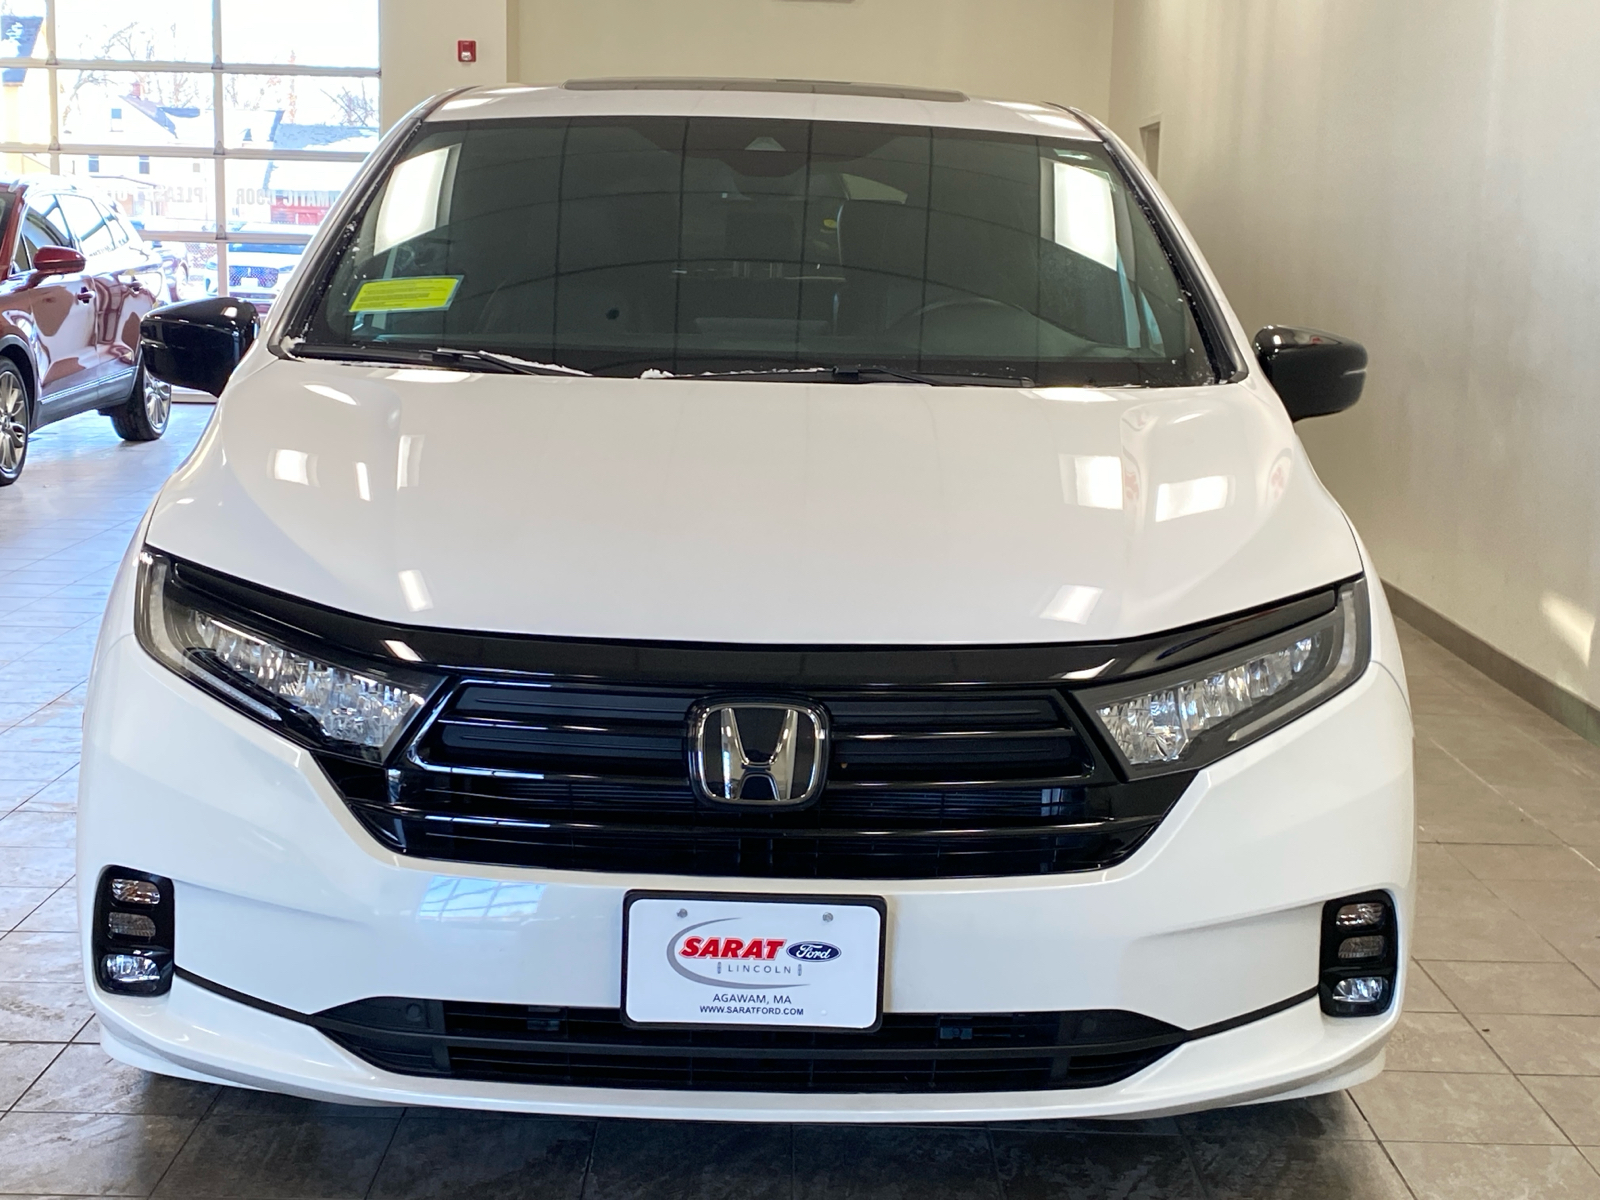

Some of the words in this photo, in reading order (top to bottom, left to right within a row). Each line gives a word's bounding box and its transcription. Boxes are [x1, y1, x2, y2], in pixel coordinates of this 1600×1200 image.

[679, 936, 787, 961] SARAT
[796, 944, 832, 959] Ford
[728, 964, 791, 974] LINCOLN
[712, 993, 770, 1005] AGAWAM,
[773, 995, 792, 1005] MA
[699, 1005, 804, 1016] WWW.SARATFORD.COM
